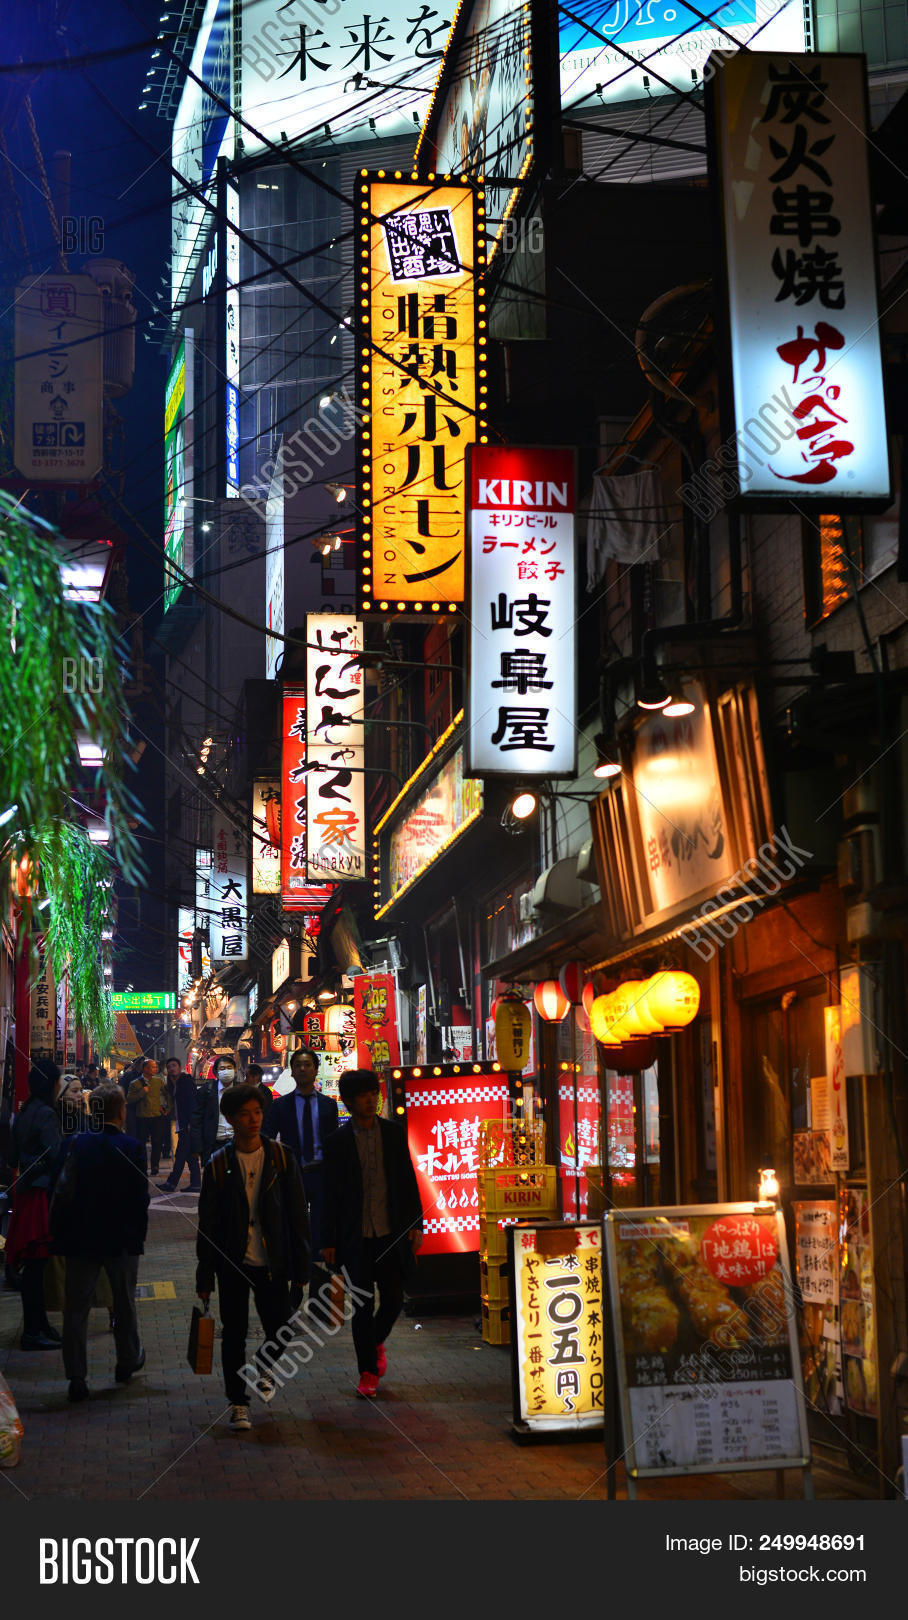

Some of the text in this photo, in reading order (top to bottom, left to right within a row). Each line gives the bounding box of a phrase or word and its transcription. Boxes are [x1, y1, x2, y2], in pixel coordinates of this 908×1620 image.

[275, 4, 452, 81] 未来を
[760, 61, 846, 310] 炭火串焼
[398, 292, 462, 584] 情熱ホルモン
[477, 478, 568, 507] KIRIN
[383, 442, 396, 584] HORUMON
[488, 513, 558, 529] キリンビール
[482, 535, 557, 554] ラーメン
[517, 560, 566, 581] 餃子
[490, 592, 555, 753] 岐阜屋
[312, 852, 362, 872] Umakyu
[221, 878, 243, 957] 大黒屋
[431, 1115, 482, 1150] 情熱
[504, 1191, 542, 1203] KIRIN
[712, 1220, 760, 1237] やっぱり
[701, 1239, 776, 1260] 「地鶏」は
[584, 1255, 604, 1408] 串焼一本からOK
